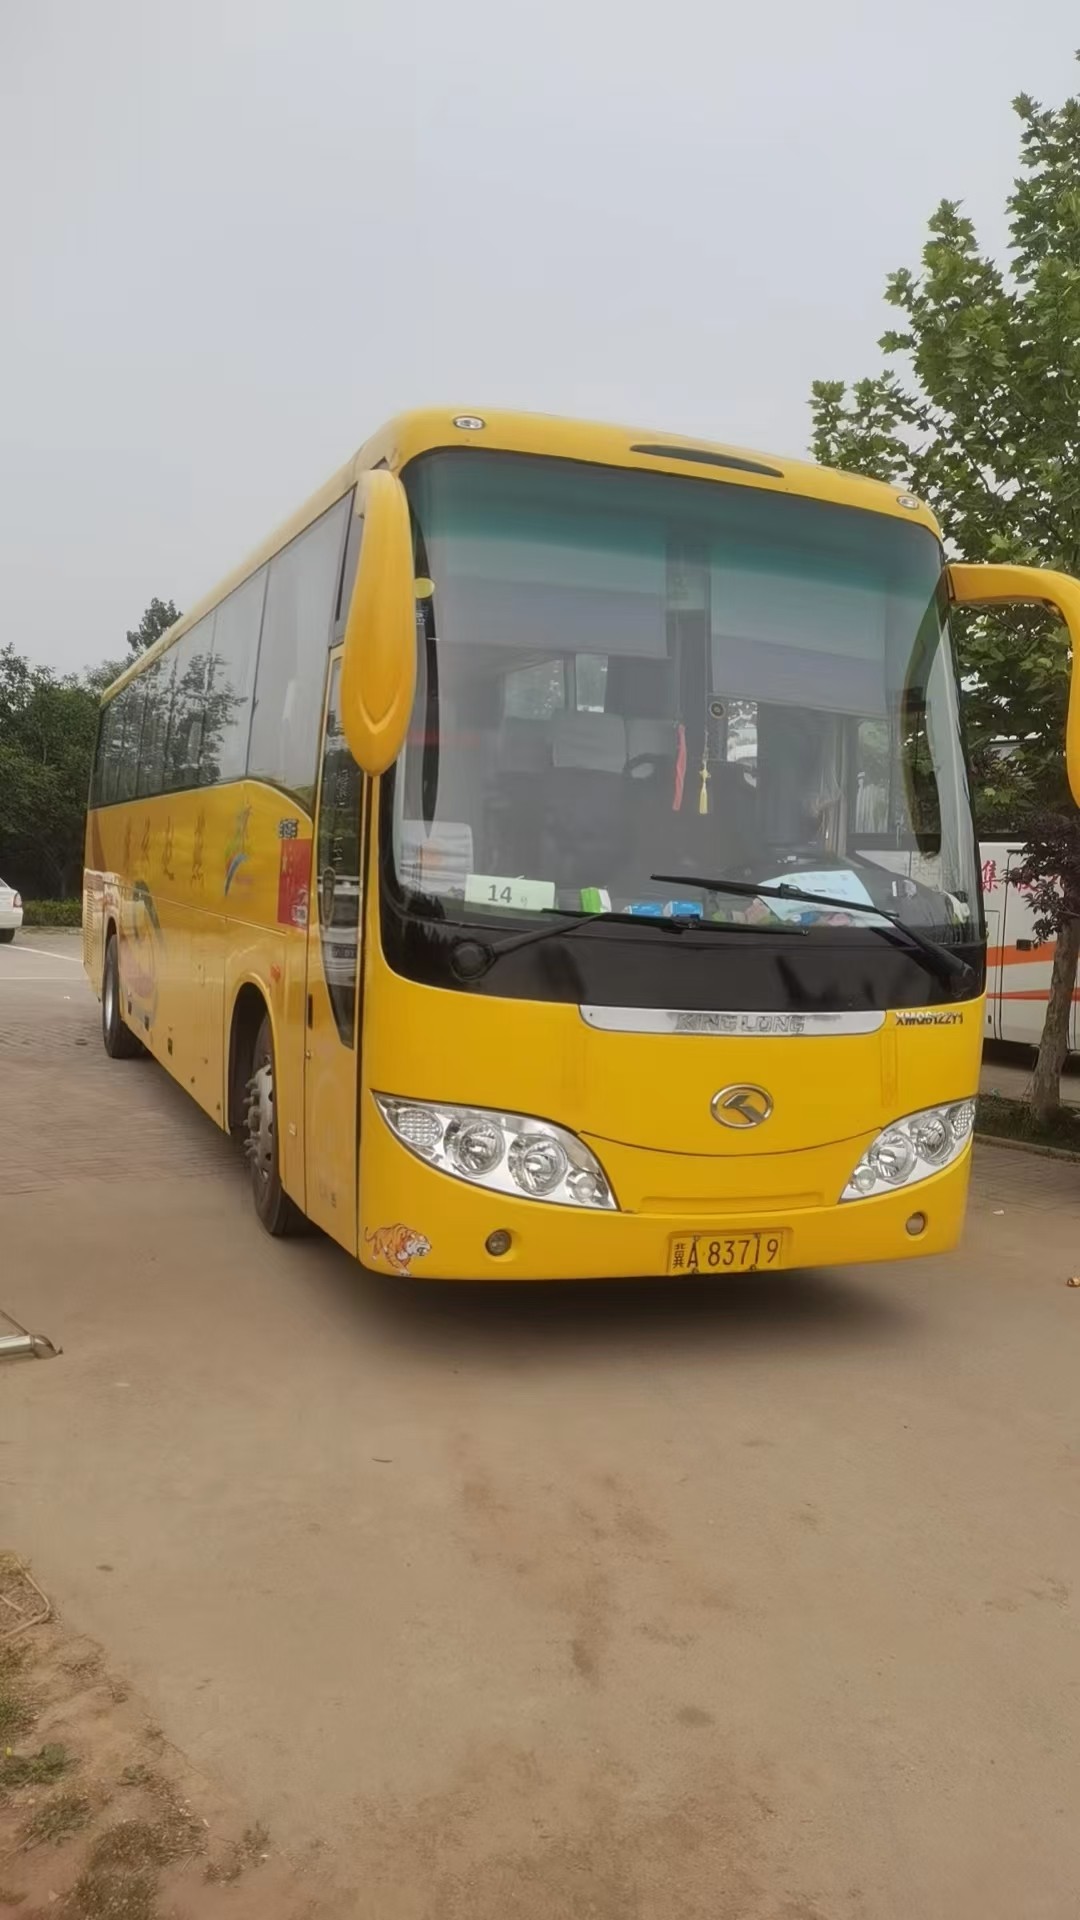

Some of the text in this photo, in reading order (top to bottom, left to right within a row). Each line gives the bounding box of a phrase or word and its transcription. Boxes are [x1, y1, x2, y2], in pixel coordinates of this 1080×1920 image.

[487, 884, 512, 903] 14
[675, 1014, 806, 1033] KING LONG
